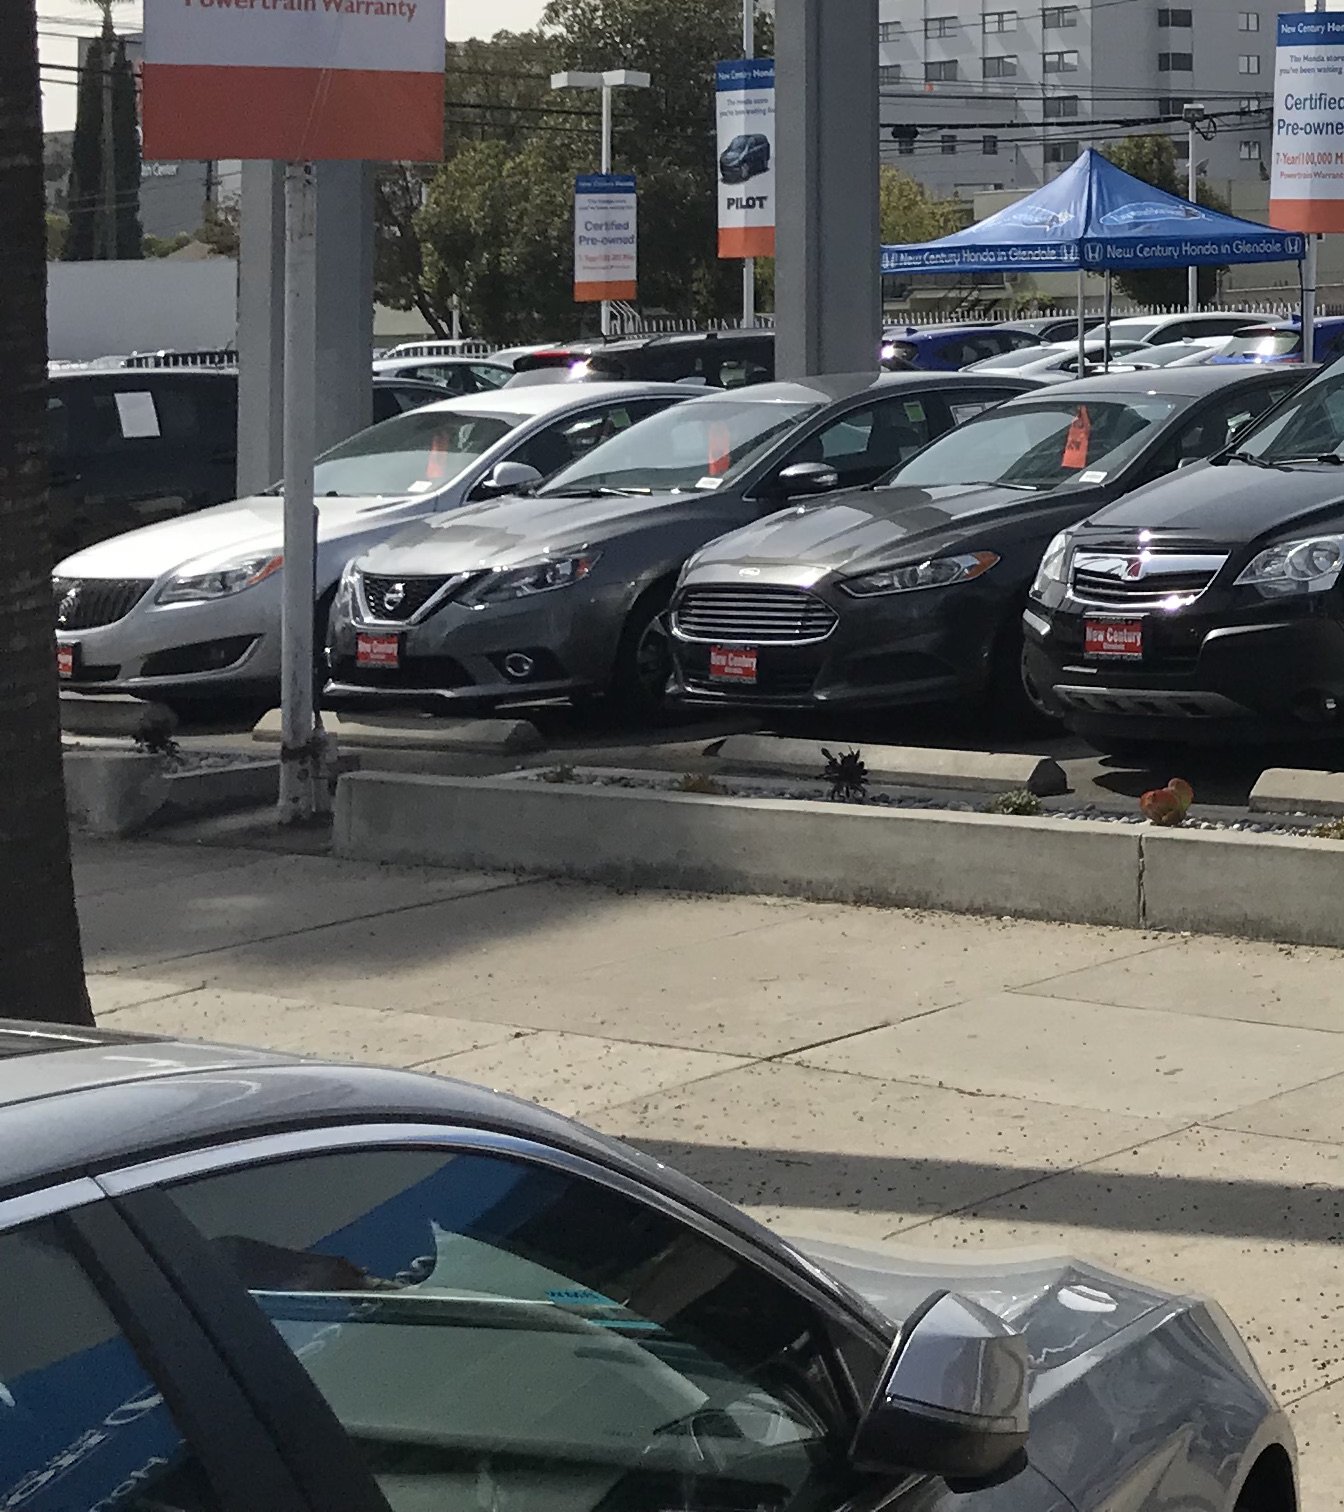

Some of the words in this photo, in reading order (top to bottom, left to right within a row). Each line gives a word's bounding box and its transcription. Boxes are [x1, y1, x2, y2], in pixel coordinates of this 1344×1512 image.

[727, 196, 768, 210] PILOT
[923, 251, 961, 266] Century
[963, 249, 995, 262] Honda
[1009, 247, 1057, 261] Glendale
[1107, 244, 1134, 259] New
[1136, 244, 1179, 259] Century
[1182, 242, 1219, 255] Honda
[1221, 242, 1231, 254] in
[1233, 239, 1282, 254] Glendale
[1107, 627, 1141, 647] Century
